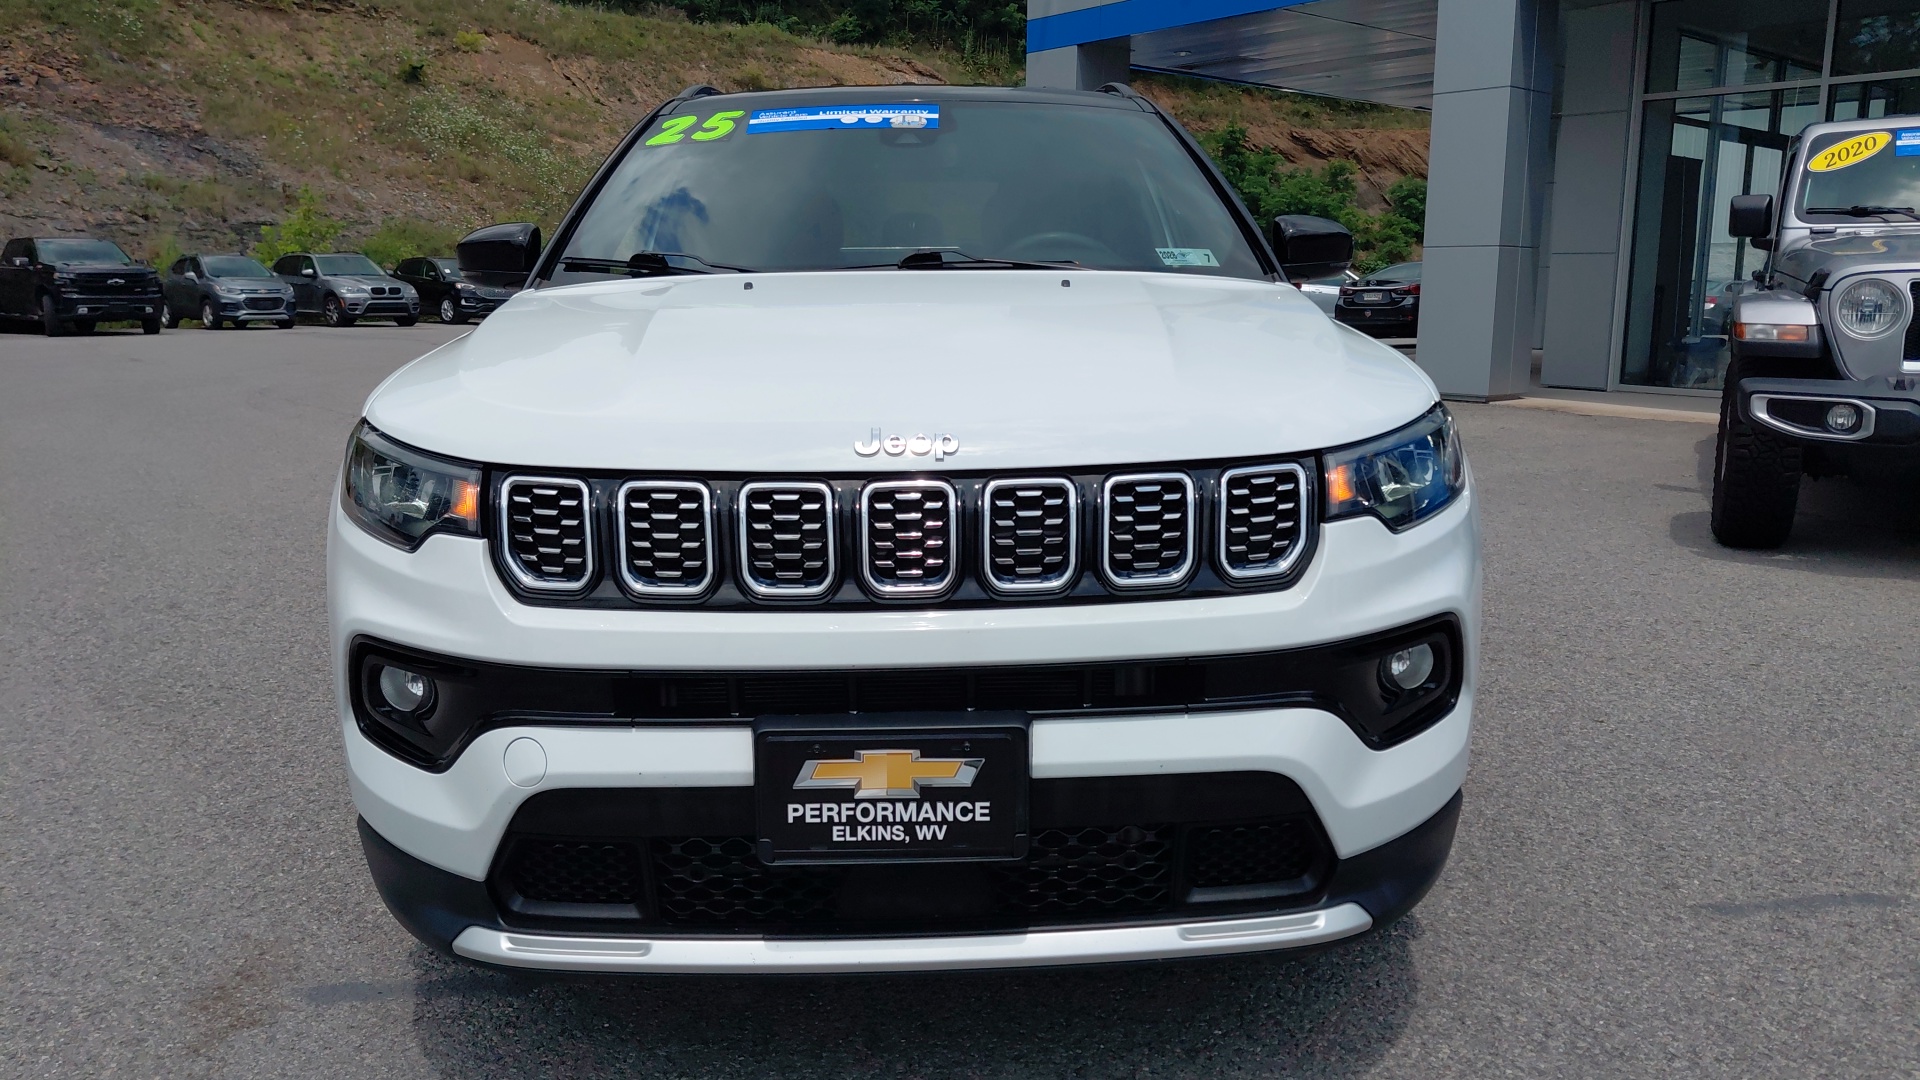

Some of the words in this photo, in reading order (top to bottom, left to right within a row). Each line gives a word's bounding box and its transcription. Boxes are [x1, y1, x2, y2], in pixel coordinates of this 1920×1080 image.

[645, 110, 746, 146] 25
[1824, 136, 1877, 169] 2020
[1203, 253, 1211, 263] 7
[853, 427, 960, 462] Jeep
[787, 801, 991, 823] PERFORMANCE
[832, 825, 910, 843] ELKINS,
[915, 825, 948, 841] WV
